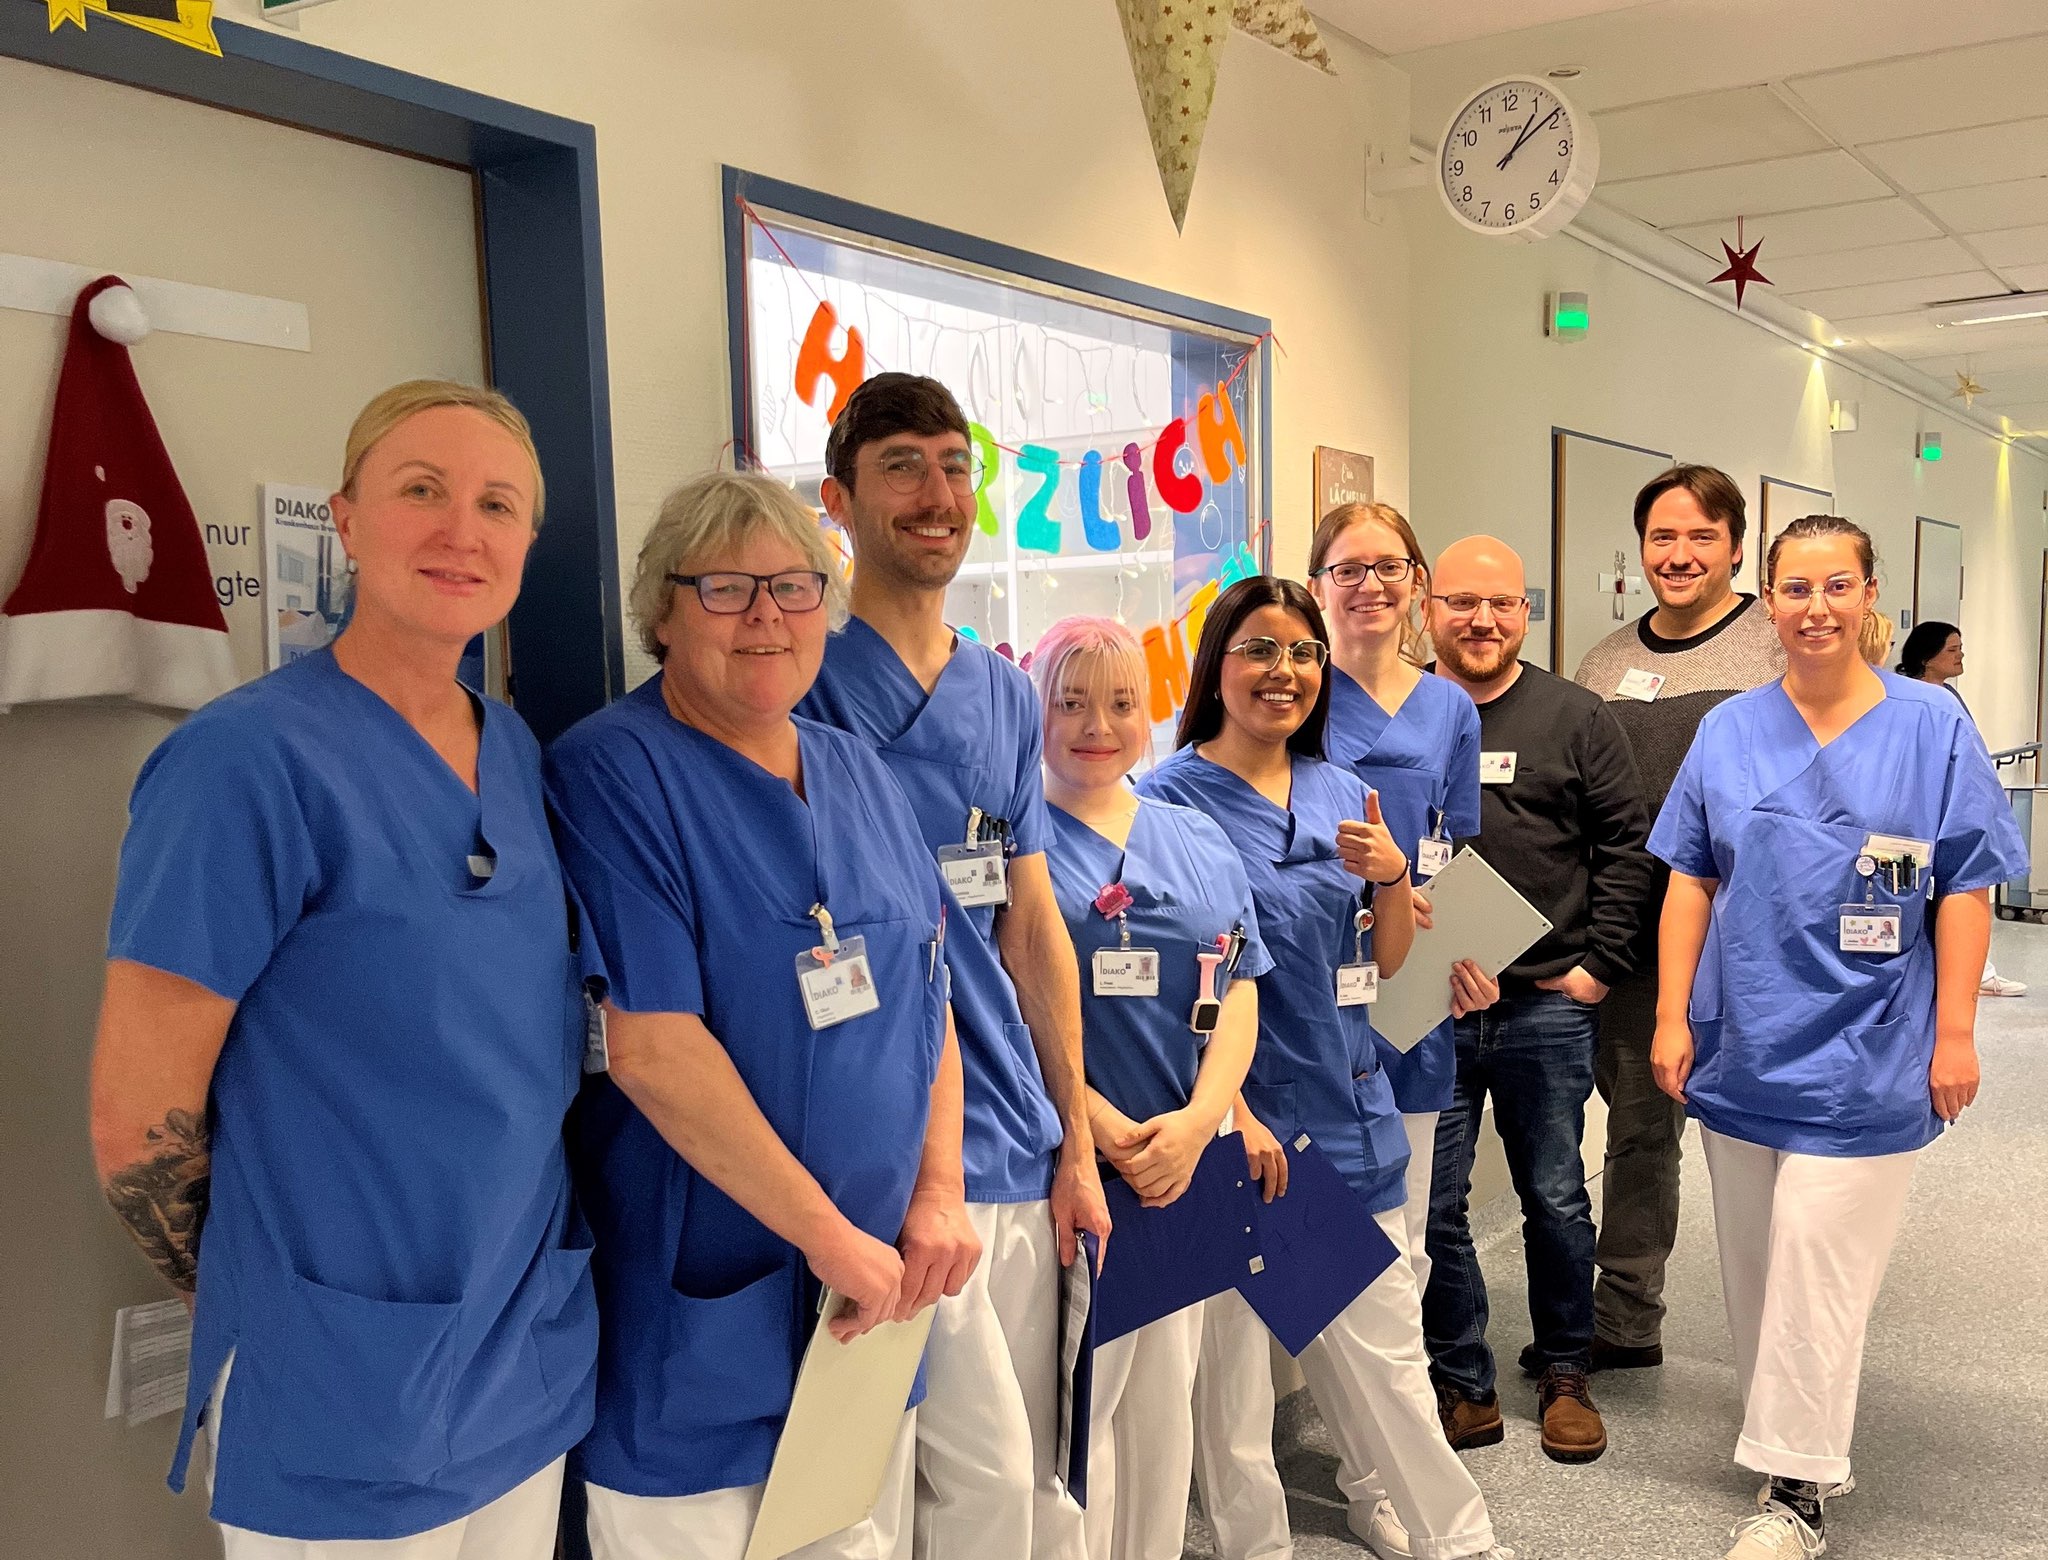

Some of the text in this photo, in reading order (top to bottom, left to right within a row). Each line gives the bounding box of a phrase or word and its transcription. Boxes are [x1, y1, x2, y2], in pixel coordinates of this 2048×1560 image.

[1501, 94, 1519, 112] 12
[1531, 97, 1538, 113] 1
[1478, 106, 1492, 124] 11
[1549, 112, 1559, 130] 2
[1461, 129, 1478, 148] 10
[1557, 139, 1569, 156] 3
[1453, 159, 1464, 176] 9
[1548, 169, 1559, 186] 4
[1462, 185, 1473, 202] 8
[1529, 192, 1541, 209] 5
[1480, 200, 1491, 218] 7
[1504, 203, 1515, 220] 6
[275, 497, 330, 521] DIAKO
[205, 523, 251, 546] nur
[216, 571, 260, 607] gte
[950, 876, 973, 885] DIAKO
[813, 985, 839, 1001] DIAKO
